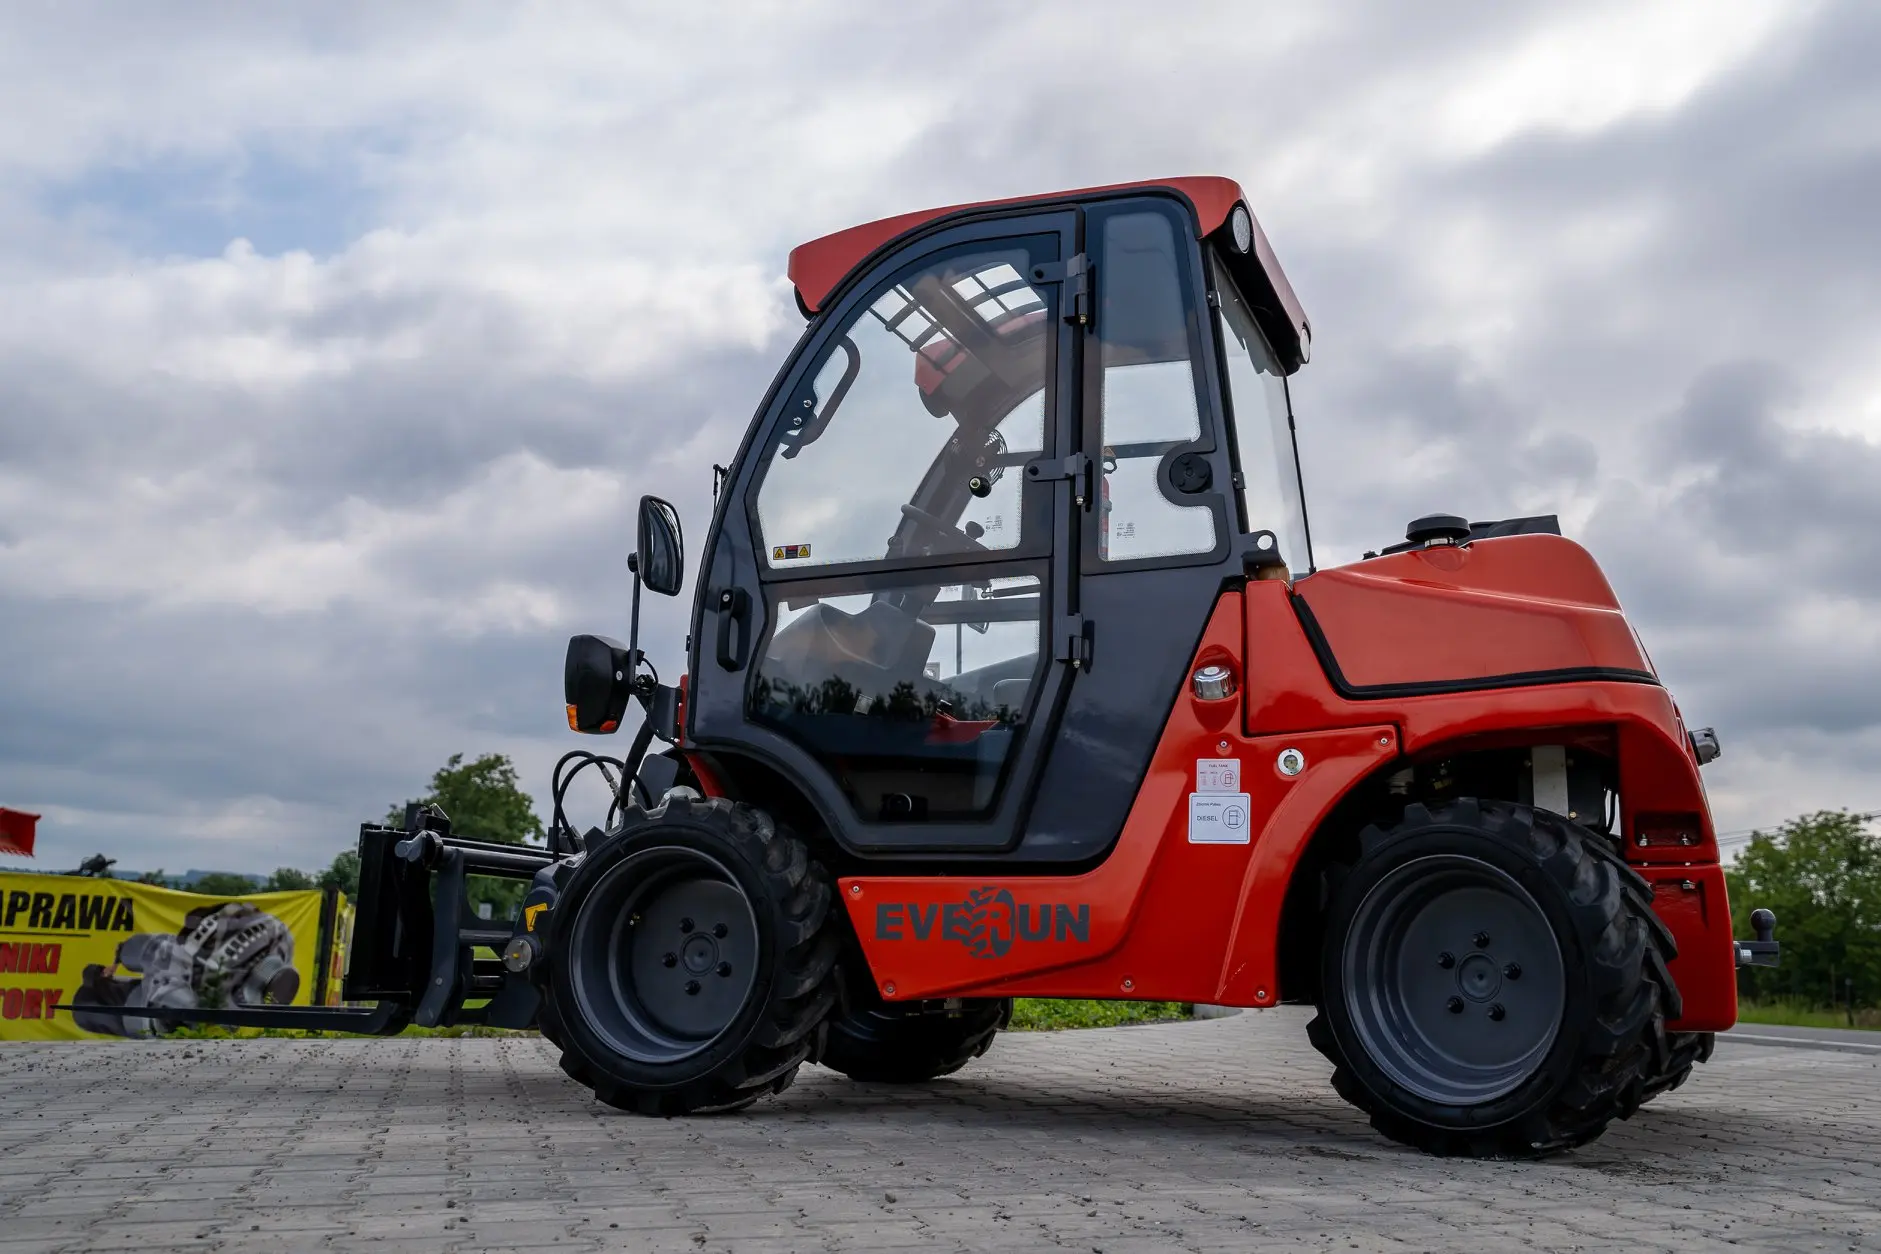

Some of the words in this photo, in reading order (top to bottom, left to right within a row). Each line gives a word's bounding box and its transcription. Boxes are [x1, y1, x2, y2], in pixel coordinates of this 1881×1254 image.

[0, 890, 134, 931] PRAWA
[875, 900, 1091, 944] EVERUN
[0, 987, 63, 1020] ORY
